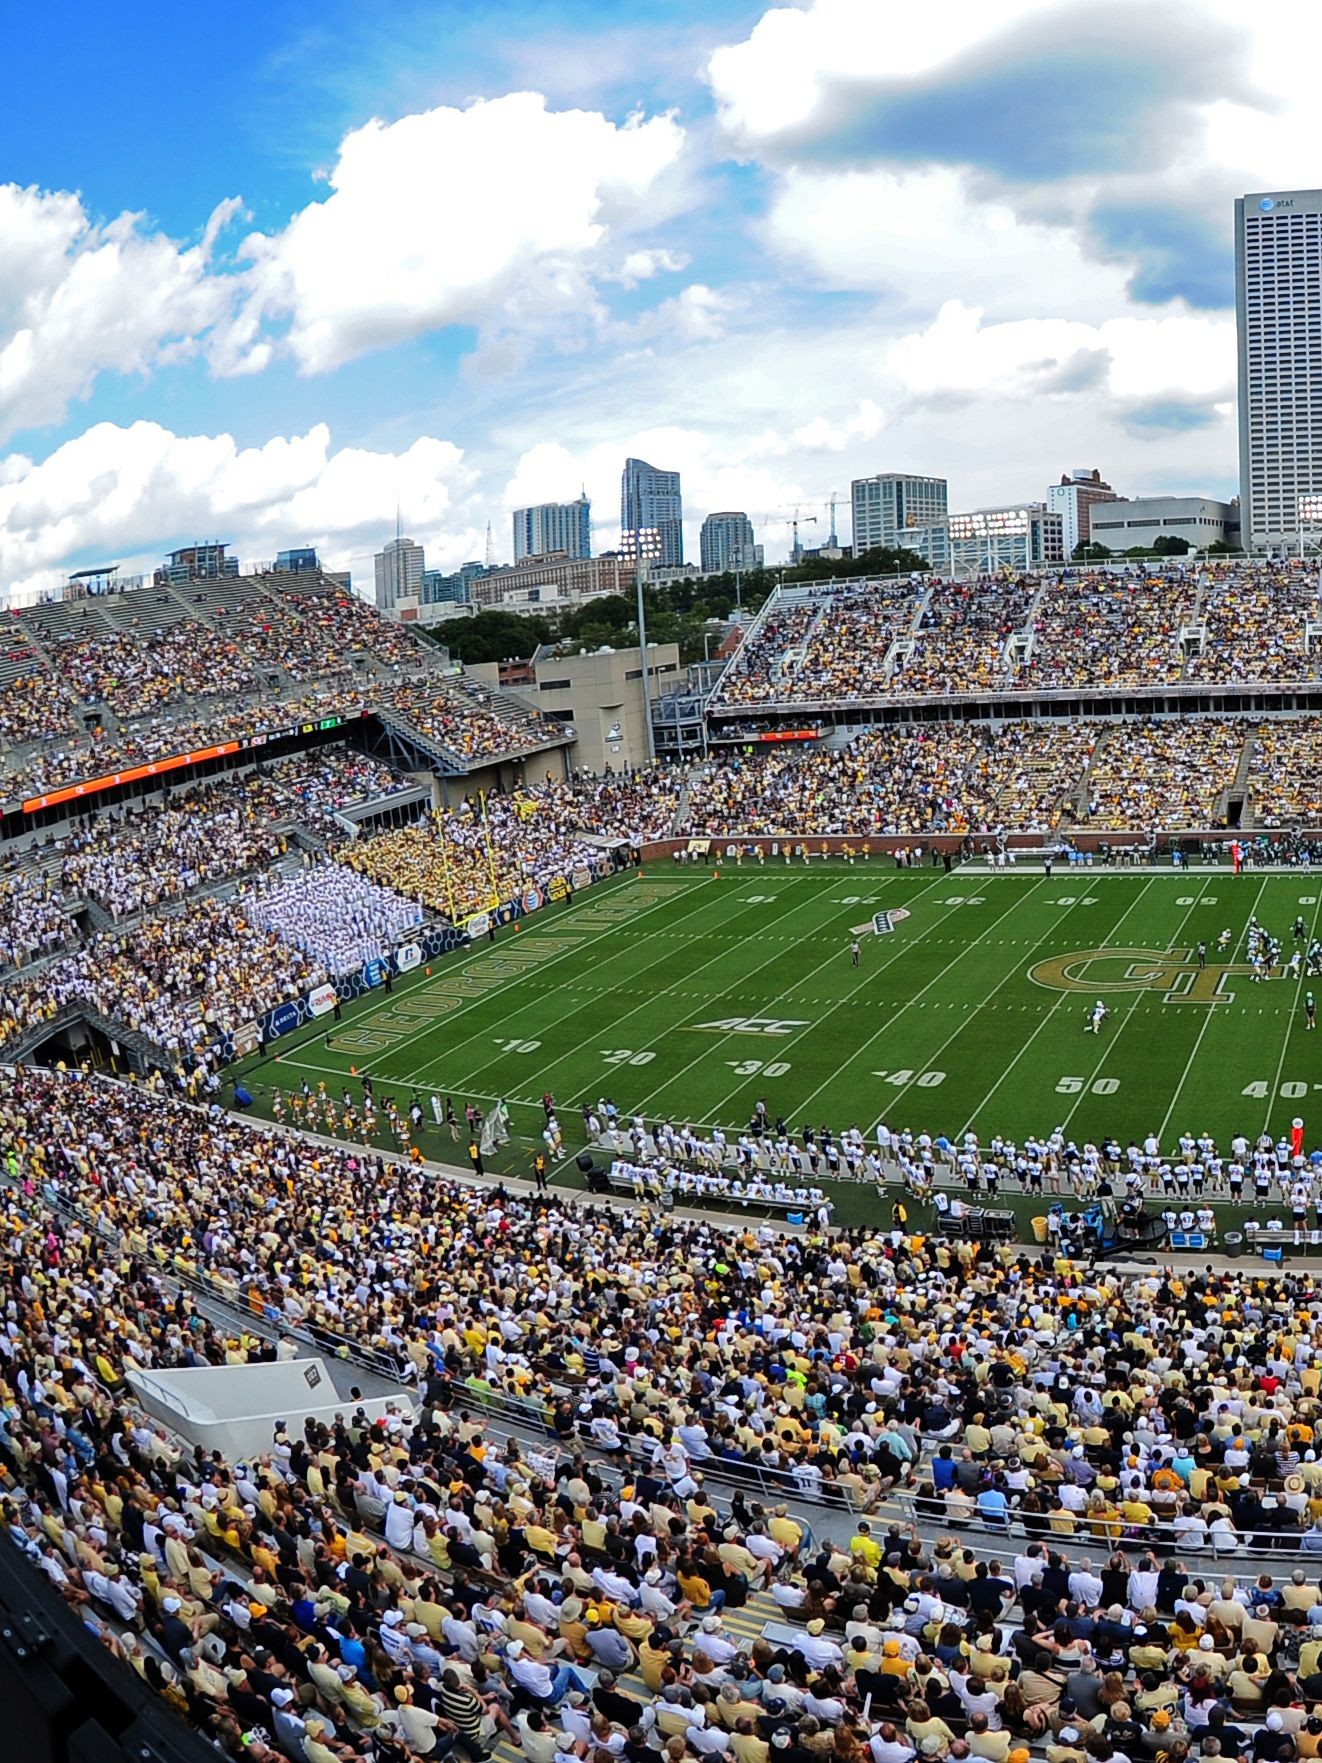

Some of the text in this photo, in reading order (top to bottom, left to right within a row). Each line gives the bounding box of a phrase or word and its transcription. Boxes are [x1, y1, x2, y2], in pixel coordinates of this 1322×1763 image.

[1027, 948, 1288, 1003] GT
[326, 936, 587, 1056] GEORGIA
[280, 1011, 297, 1023] DELTA
[690, 1017, 810, 1034] ACC
[501, 1039, 542, 1053] 10
[603, 1050, 657, 1066] 20
[733, 1060, 791, 1078] 30
[884, 1070, 948, 1088] 40
[1054, 1076, 1121, 1096] 50
[1241, 1080, 1308, 1098] 40
